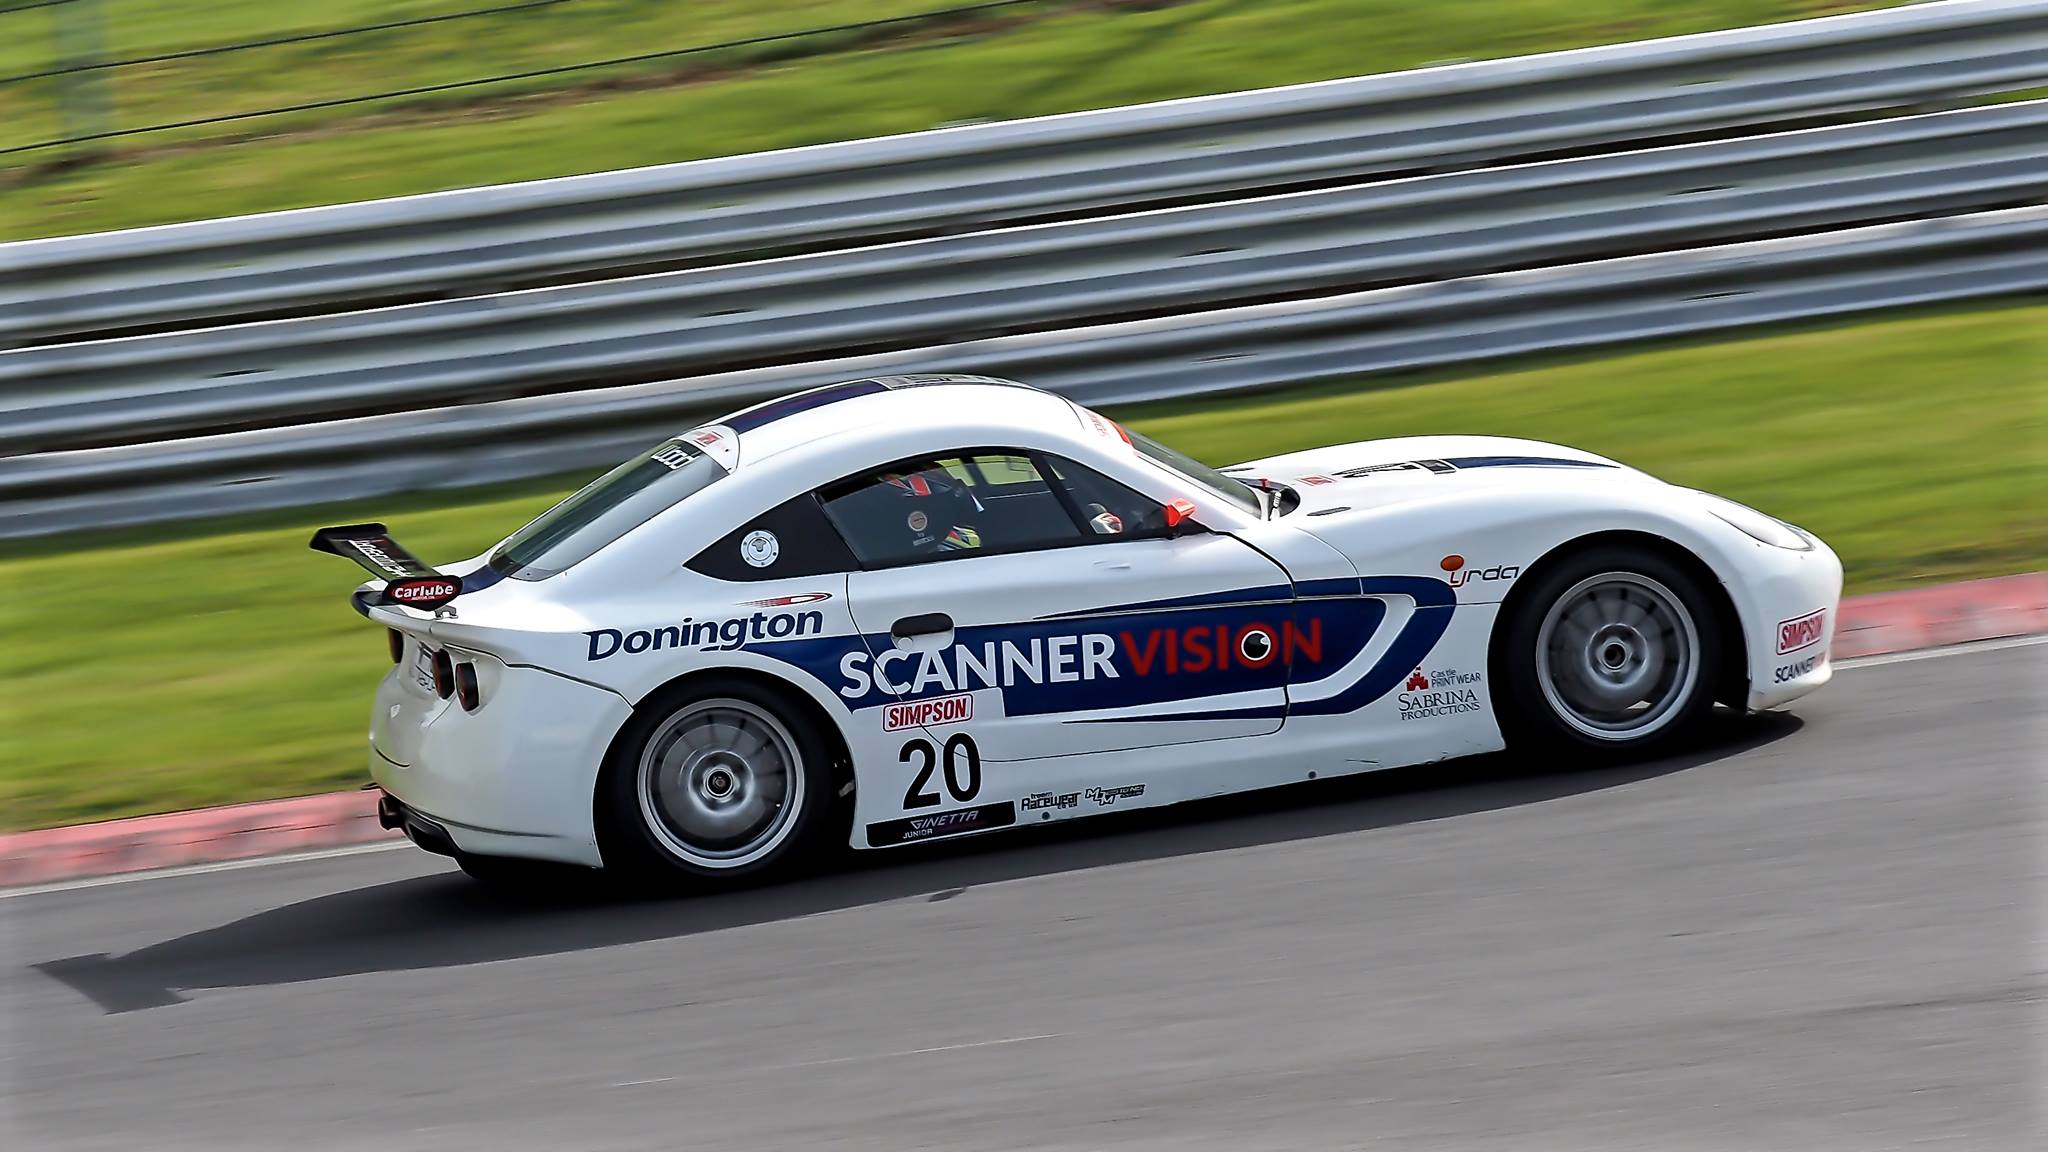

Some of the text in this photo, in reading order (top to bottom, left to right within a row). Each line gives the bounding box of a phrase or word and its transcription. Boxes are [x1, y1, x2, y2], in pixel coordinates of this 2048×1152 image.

[394, 585, 454, 599] Carlube
[582, 610, 823, 662] Donington
[1456, 672, 1481, 684] WEAR
[1398, 688, 1478, 712] SABRINA
[888, 698, 968, 728] SIMPSON
[1401, 701, 1480, 721] PRODUCTIONS
[898, 732, 982, 811] 20
[1020, 793, 1082, 812] Racewear
[910, 810, 979, 830] GINETTA
[902, 828, 934, 840] JUNIOR
